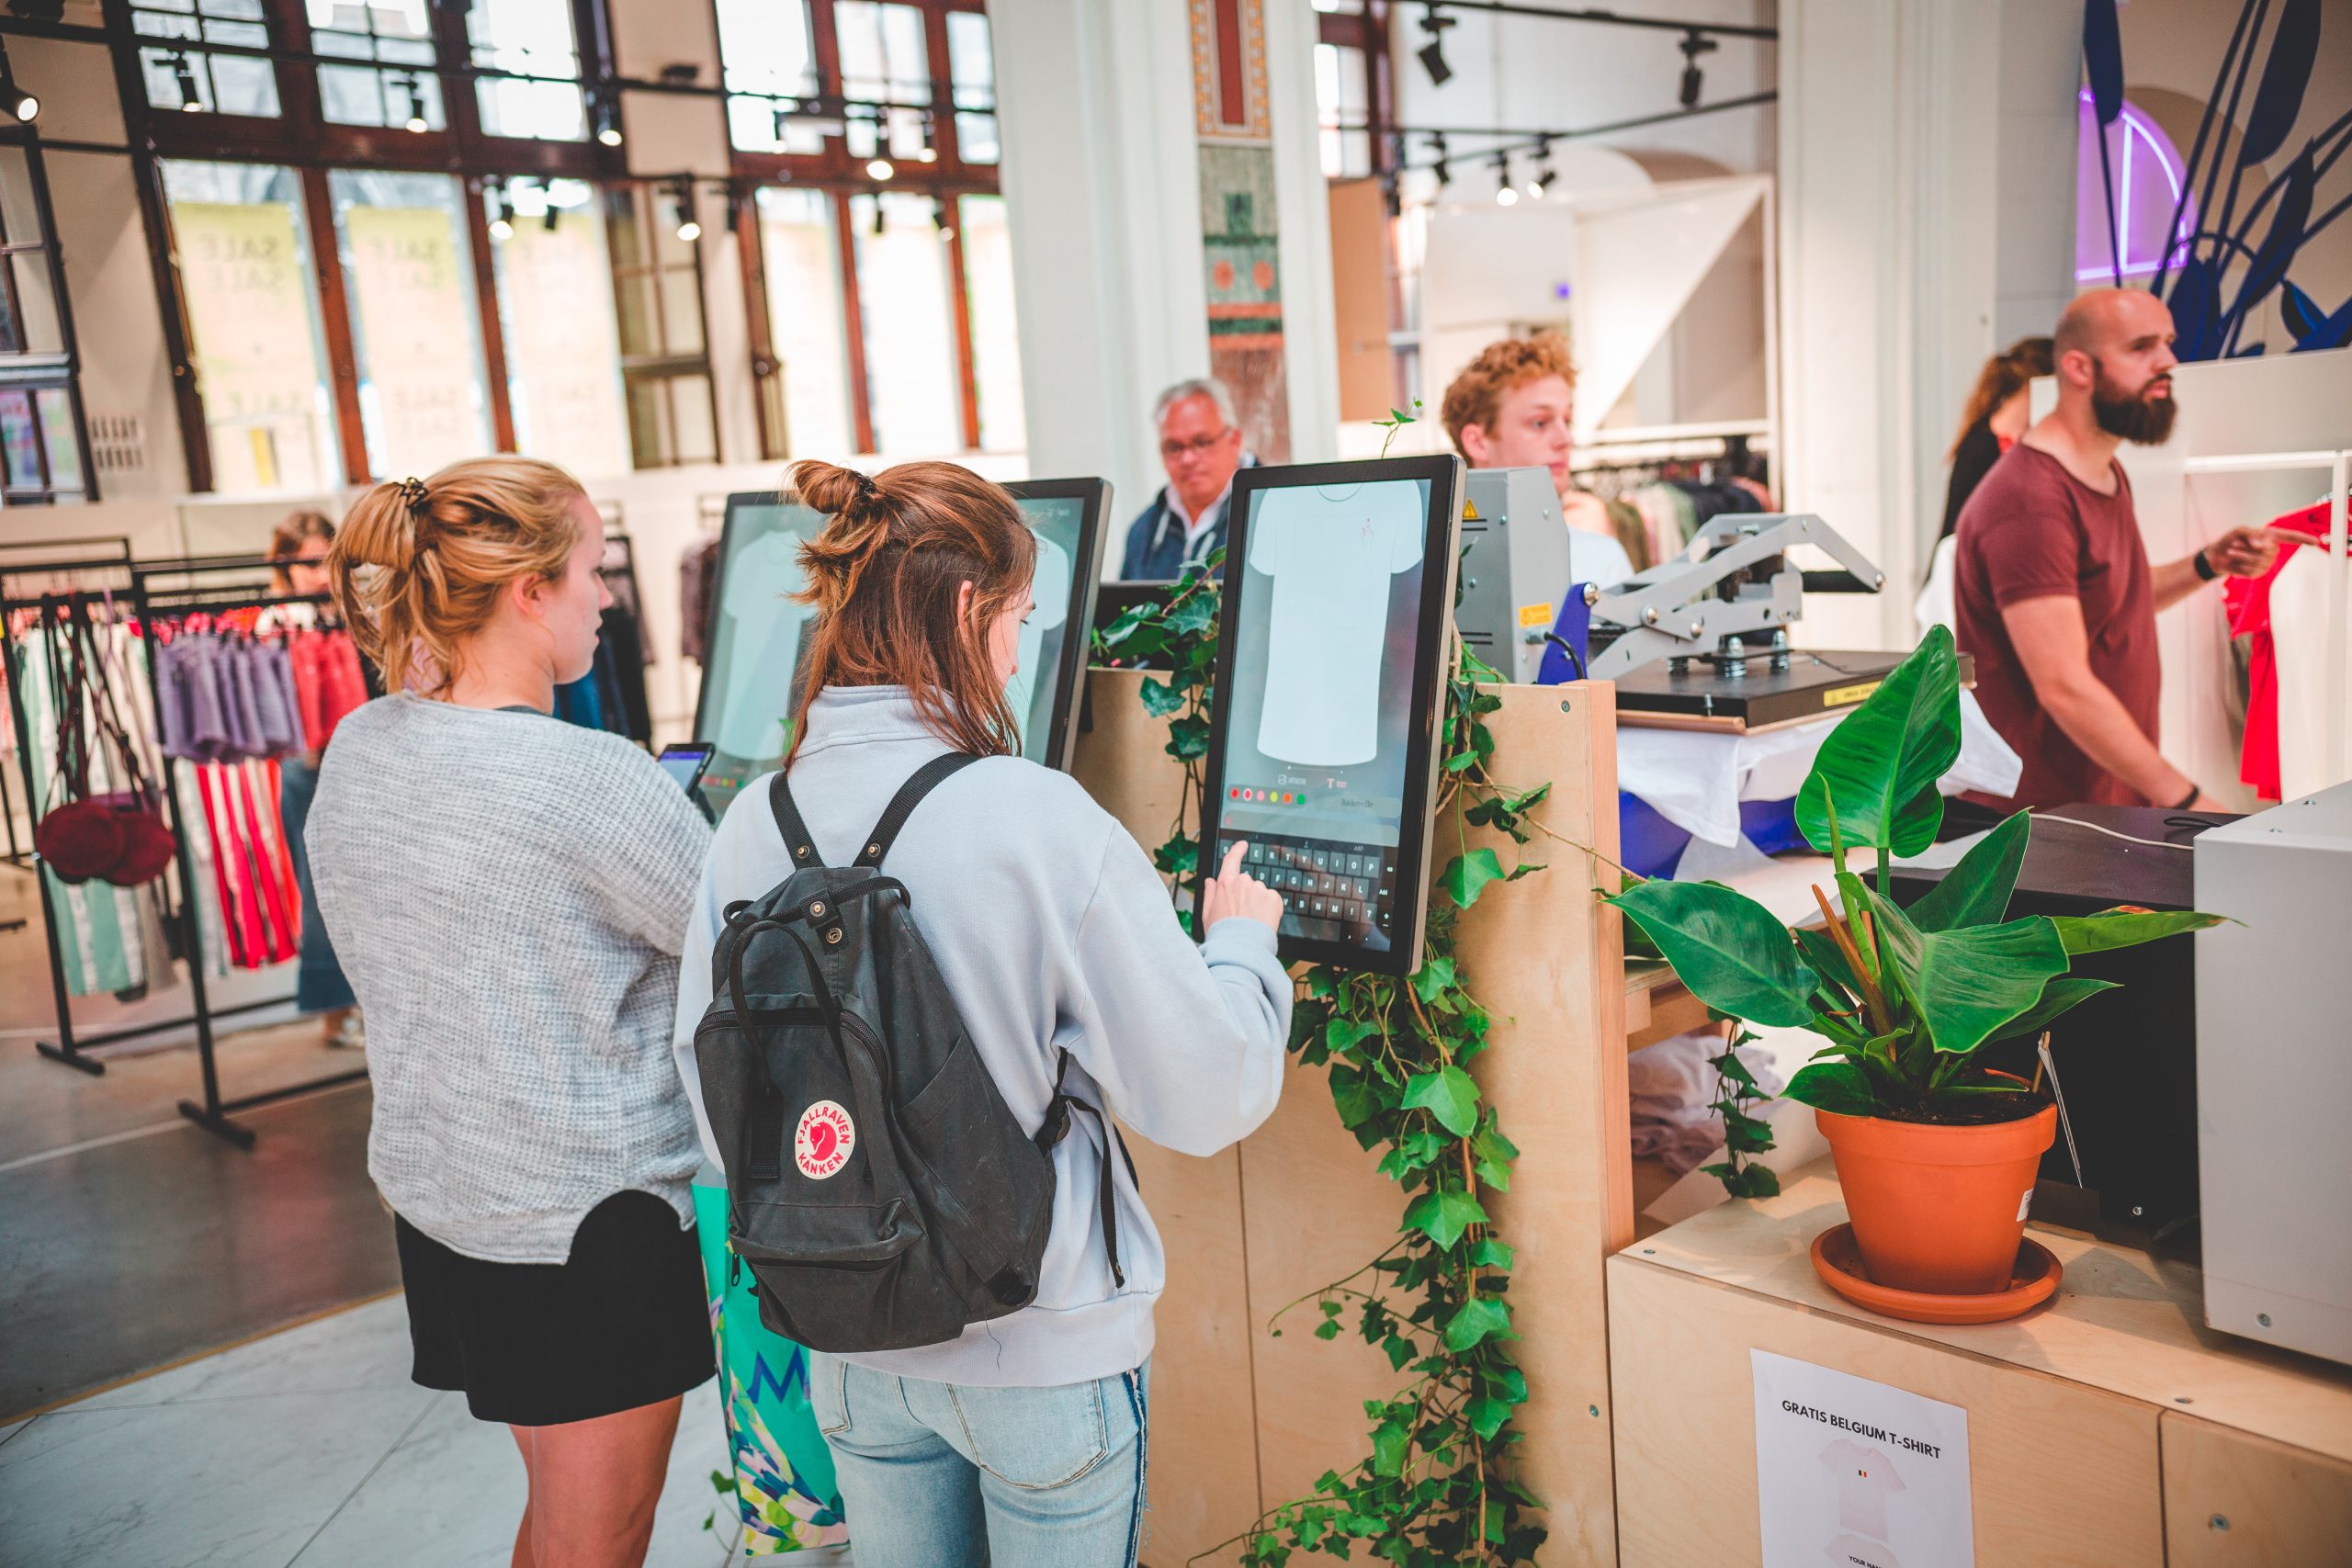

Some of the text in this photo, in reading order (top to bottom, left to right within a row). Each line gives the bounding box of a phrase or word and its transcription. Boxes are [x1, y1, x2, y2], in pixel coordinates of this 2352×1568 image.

[1341, 797, 1374, 808] Baskerville
[1781, 1400, 1941, 1459] GRATIS BELGIUM T-SHIRT
[1849, 1554, 1866, 1566] YOUR
